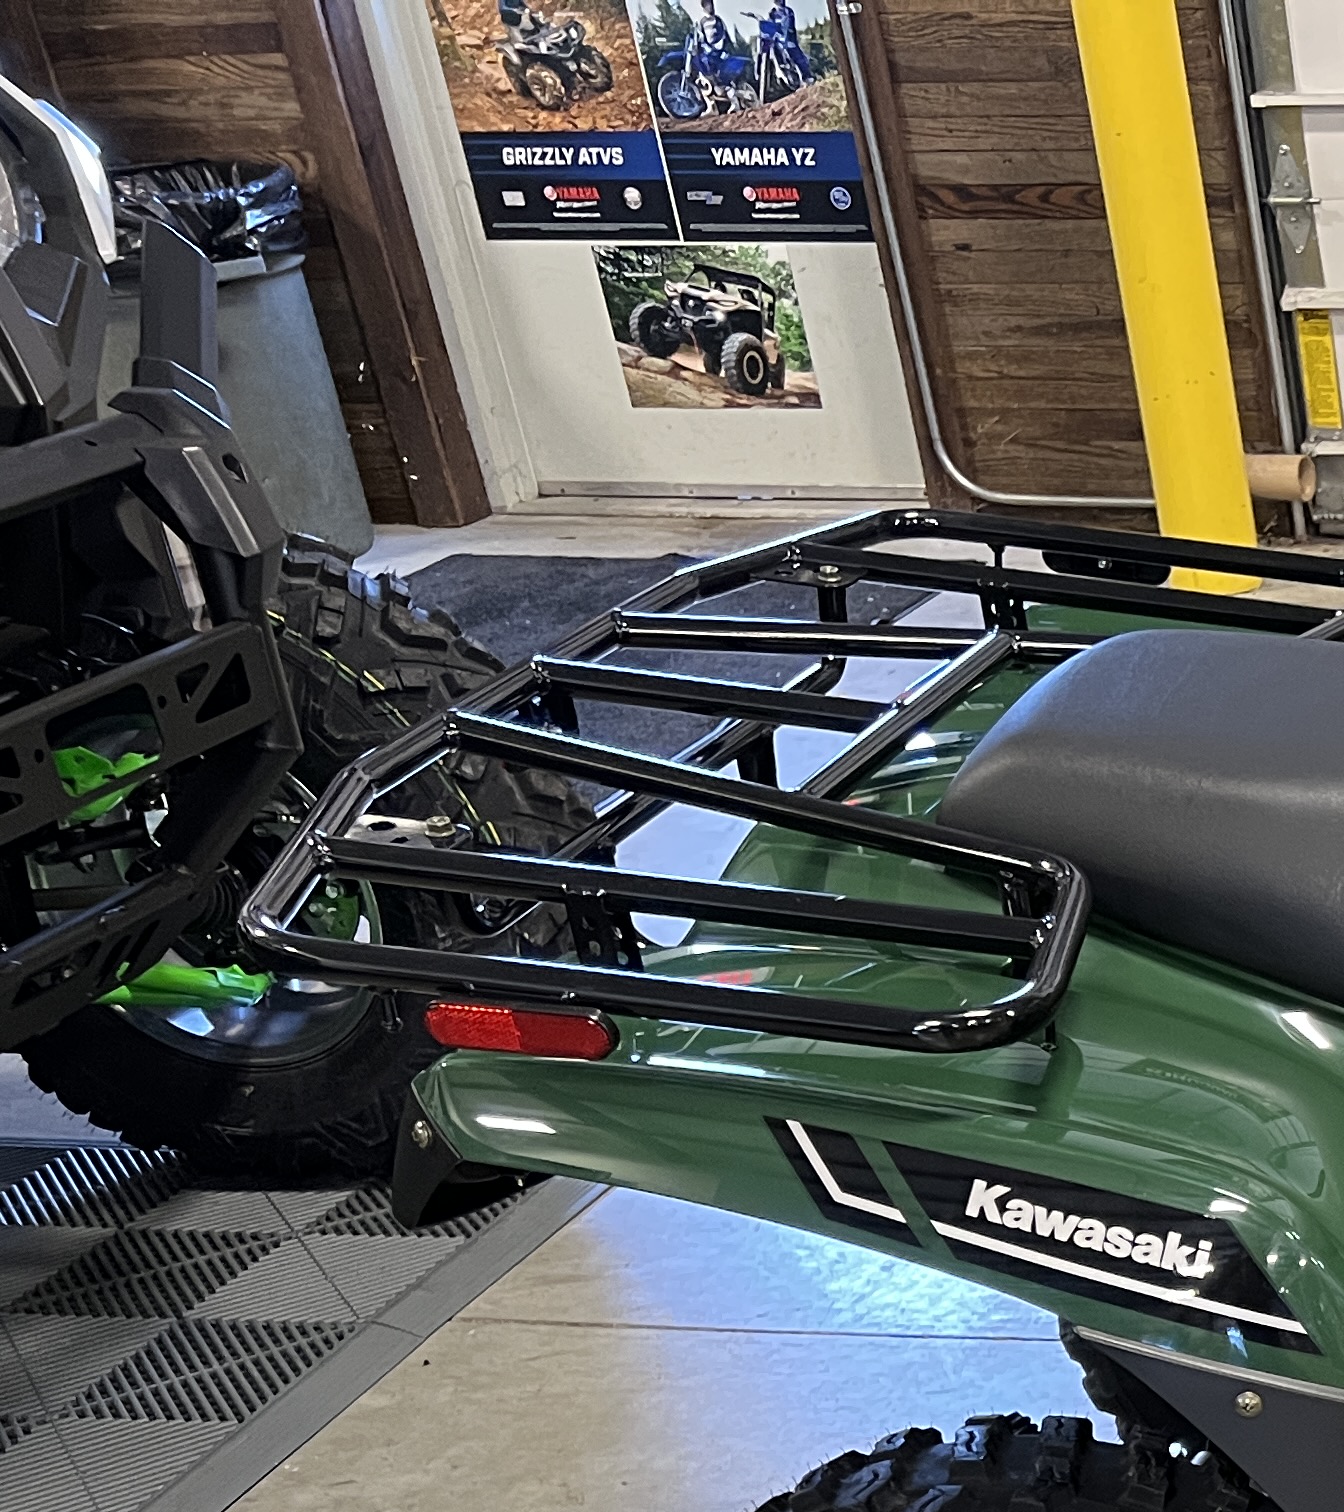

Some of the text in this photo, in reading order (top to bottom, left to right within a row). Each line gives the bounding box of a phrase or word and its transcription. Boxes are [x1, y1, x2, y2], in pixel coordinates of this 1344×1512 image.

[502, 147, 624, 166] GRIZZLY ATVS
[711, 147, 816, 166] YAMAHA YZ
[556, 187, 601, 200] YAMAHA
[755, 187, 800, 201] YAMAHA
[964, 1177, 1216, 1281] Kawasaki
